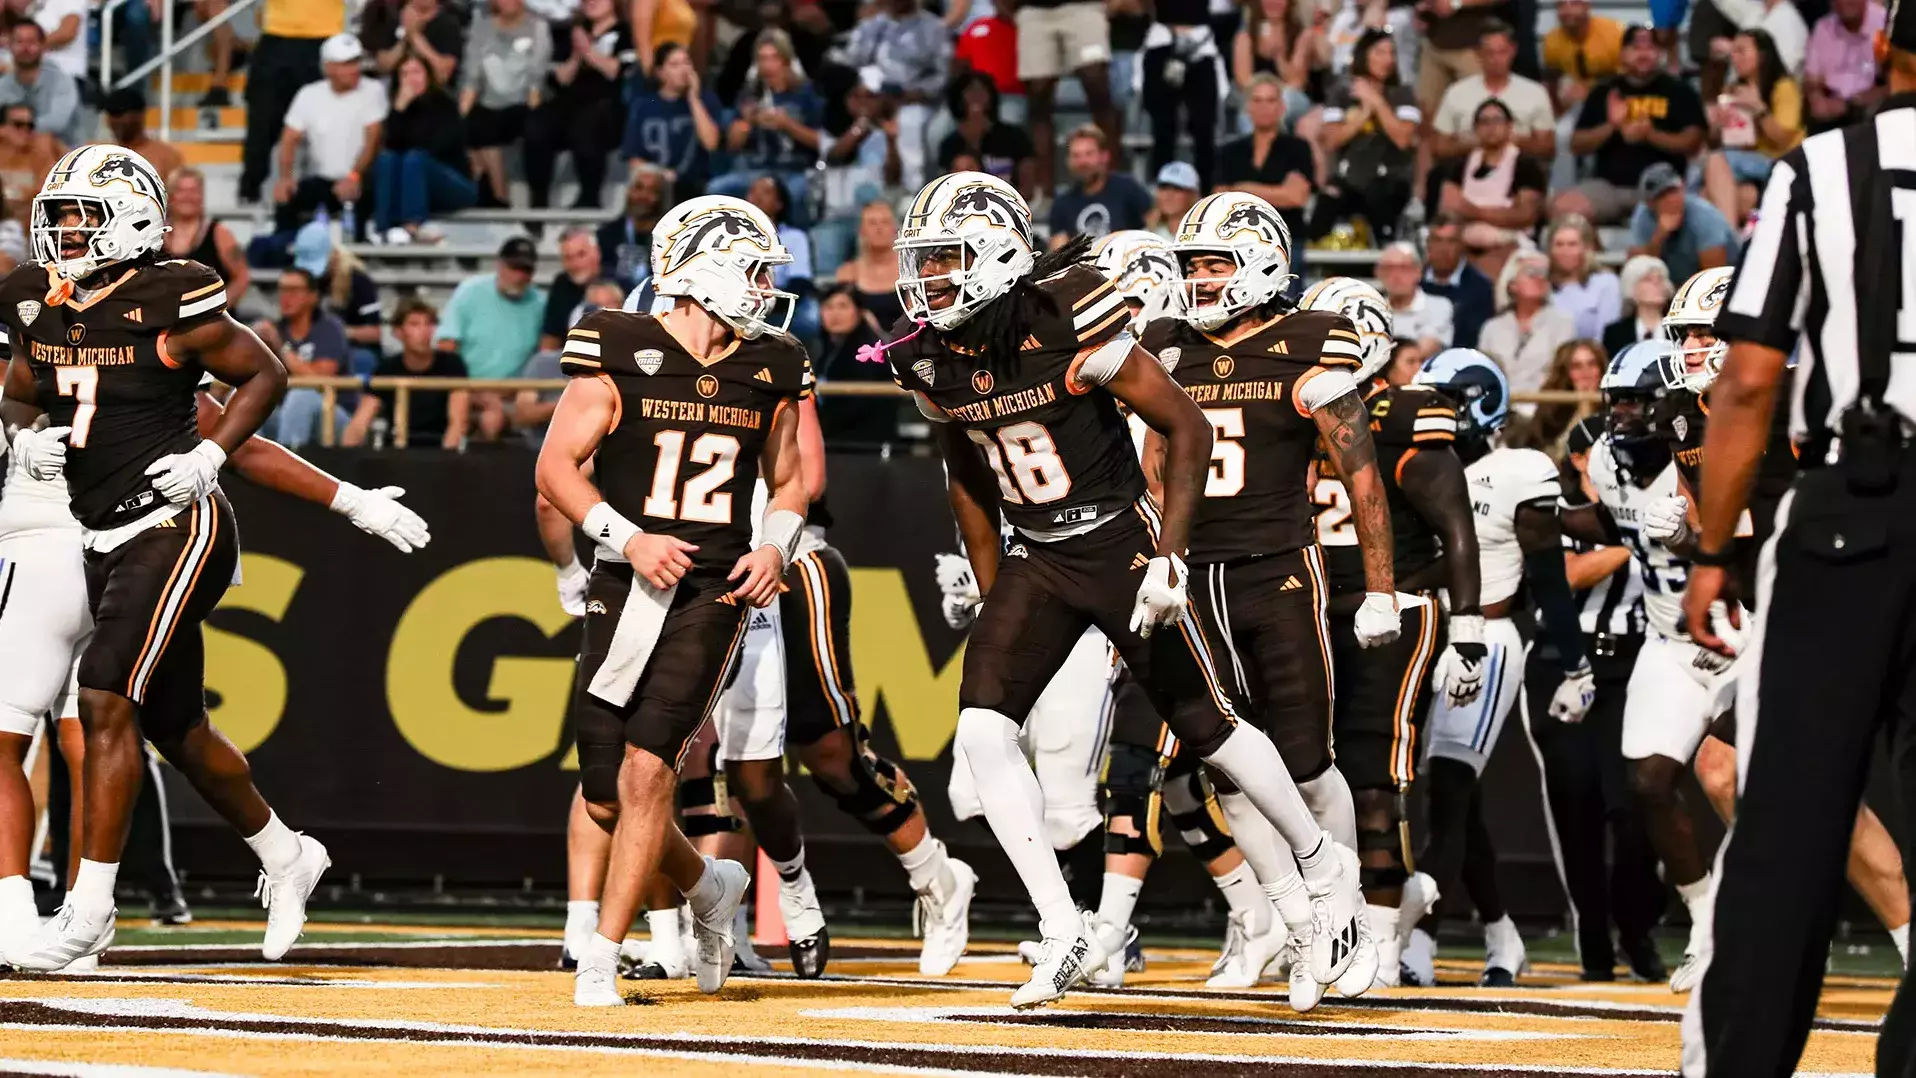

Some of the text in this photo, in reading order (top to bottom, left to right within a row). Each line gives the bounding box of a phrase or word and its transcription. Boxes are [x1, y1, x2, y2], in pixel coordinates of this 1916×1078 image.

[47, 182, 64, 190] GRIT
[904, 229, 921, 238] GRIT
[31, 340, 135, 366] WESTERN MICHIGAN
[1217, 360, 1230, 374] W
[701, 380, 714, 394] W
[975, 375, 990, 391] W
[1185, 382, 1283, 402] TERN MICHIGAN
[55, 364, 99, 449] 7
[994, 382, 1056, 416] MICHIGAN
[641, 398, 761, 430] WESTERN MICHIGAN
[965, 420, 1072, 505] 18
[1201, 407, 1246, 498] 5
[643, 429, 741, 524] 12
